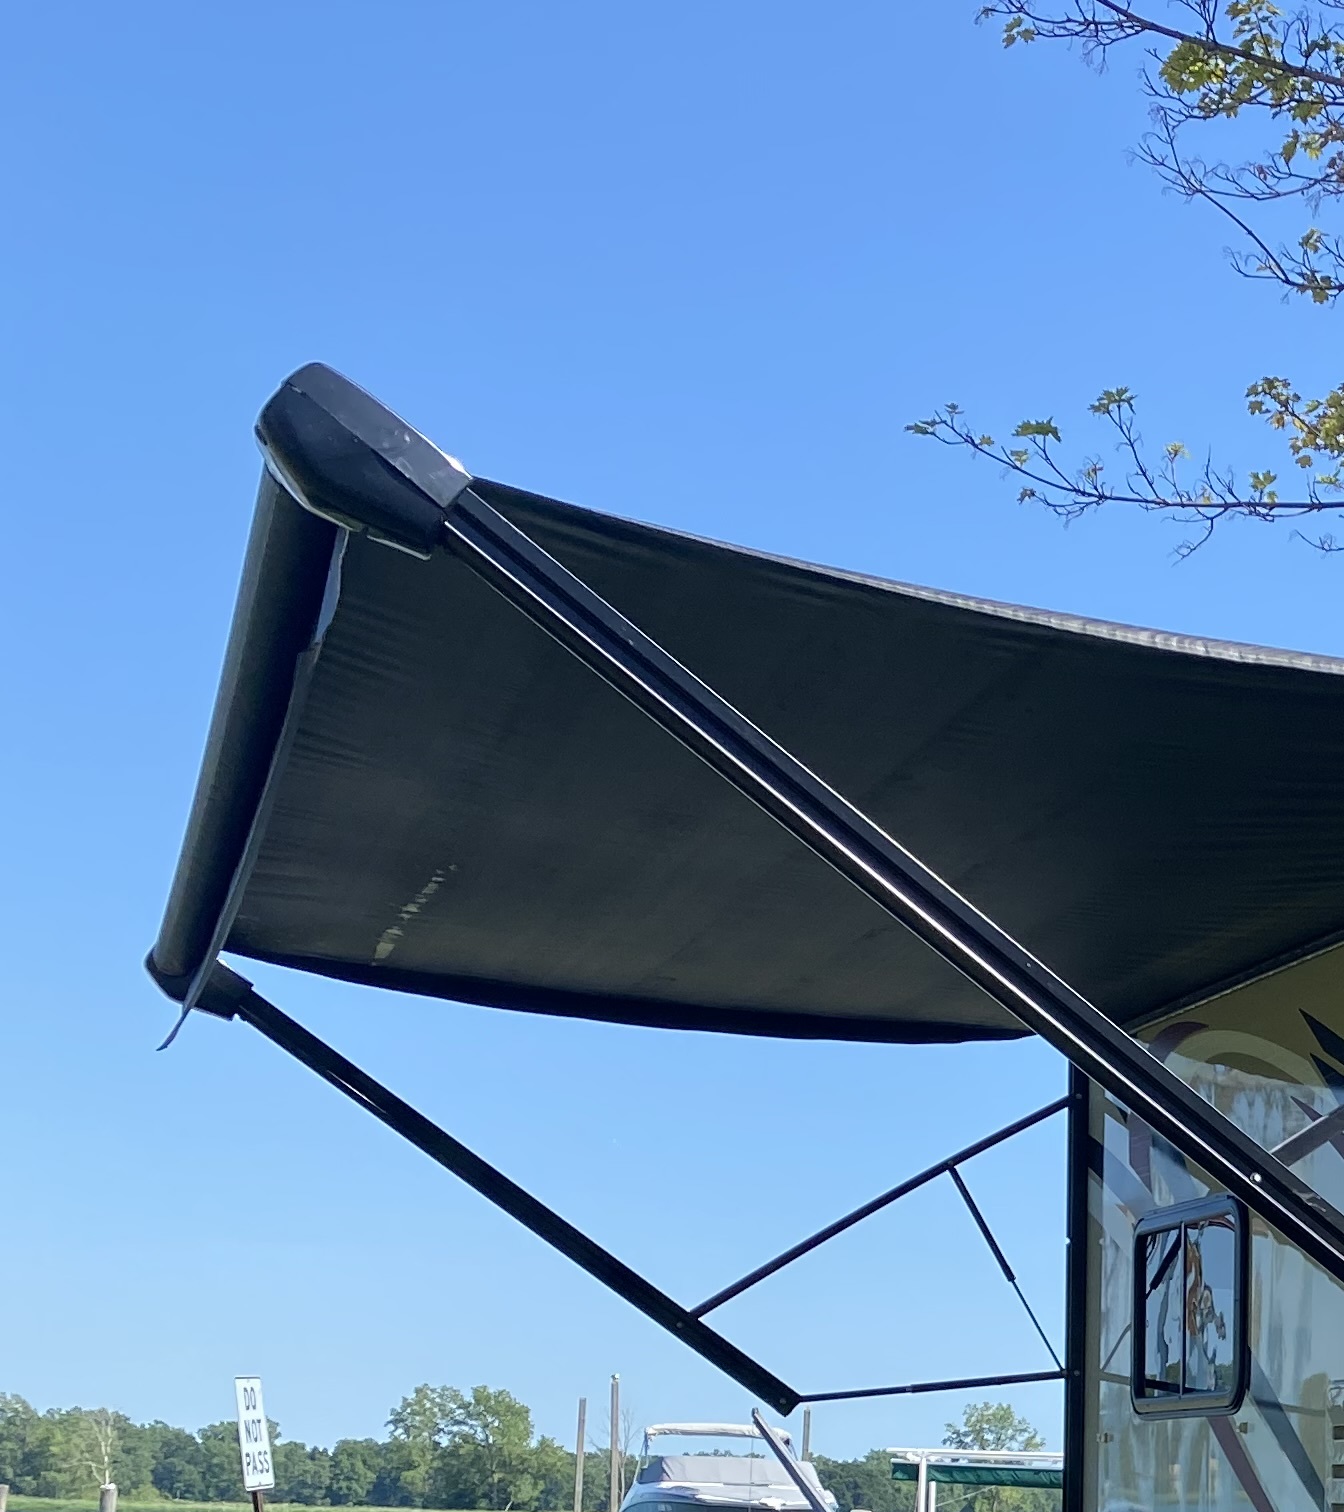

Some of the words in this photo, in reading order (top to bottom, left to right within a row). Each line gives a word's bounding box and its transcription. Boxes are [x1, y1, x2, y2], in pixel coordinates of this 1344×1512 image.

[243, 1386, 256, 1411] DO
[244, 1418, 262, 1443] NOT
[245, 1450, 270, 1476] PASS
